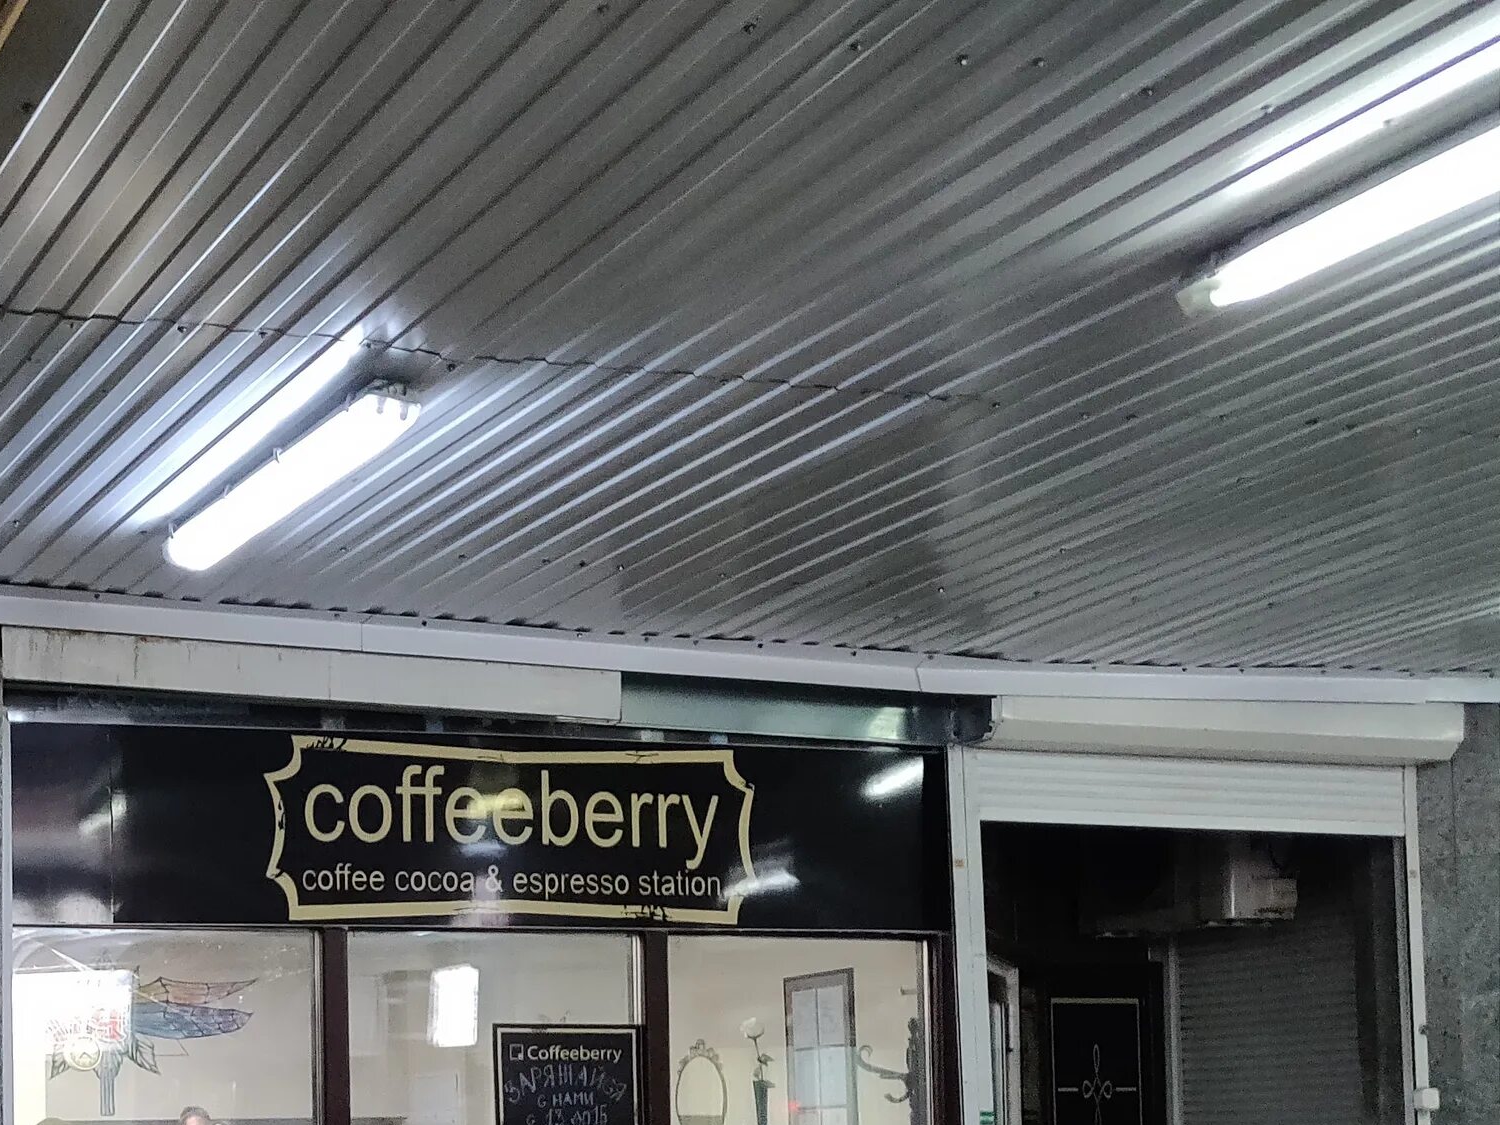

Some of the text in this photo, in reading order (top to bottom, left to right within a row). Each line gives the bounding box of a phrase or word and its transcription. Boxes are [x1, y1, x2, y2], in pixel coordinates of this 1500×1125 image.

[304, 765, 719, 869] coffeeberry
[302, 863, 723, 899] coffee cocoa & espresso station
[527, 1045, 622, 1063] Coffeeberry
[552, 1091, 594, 1107] НАМИ
